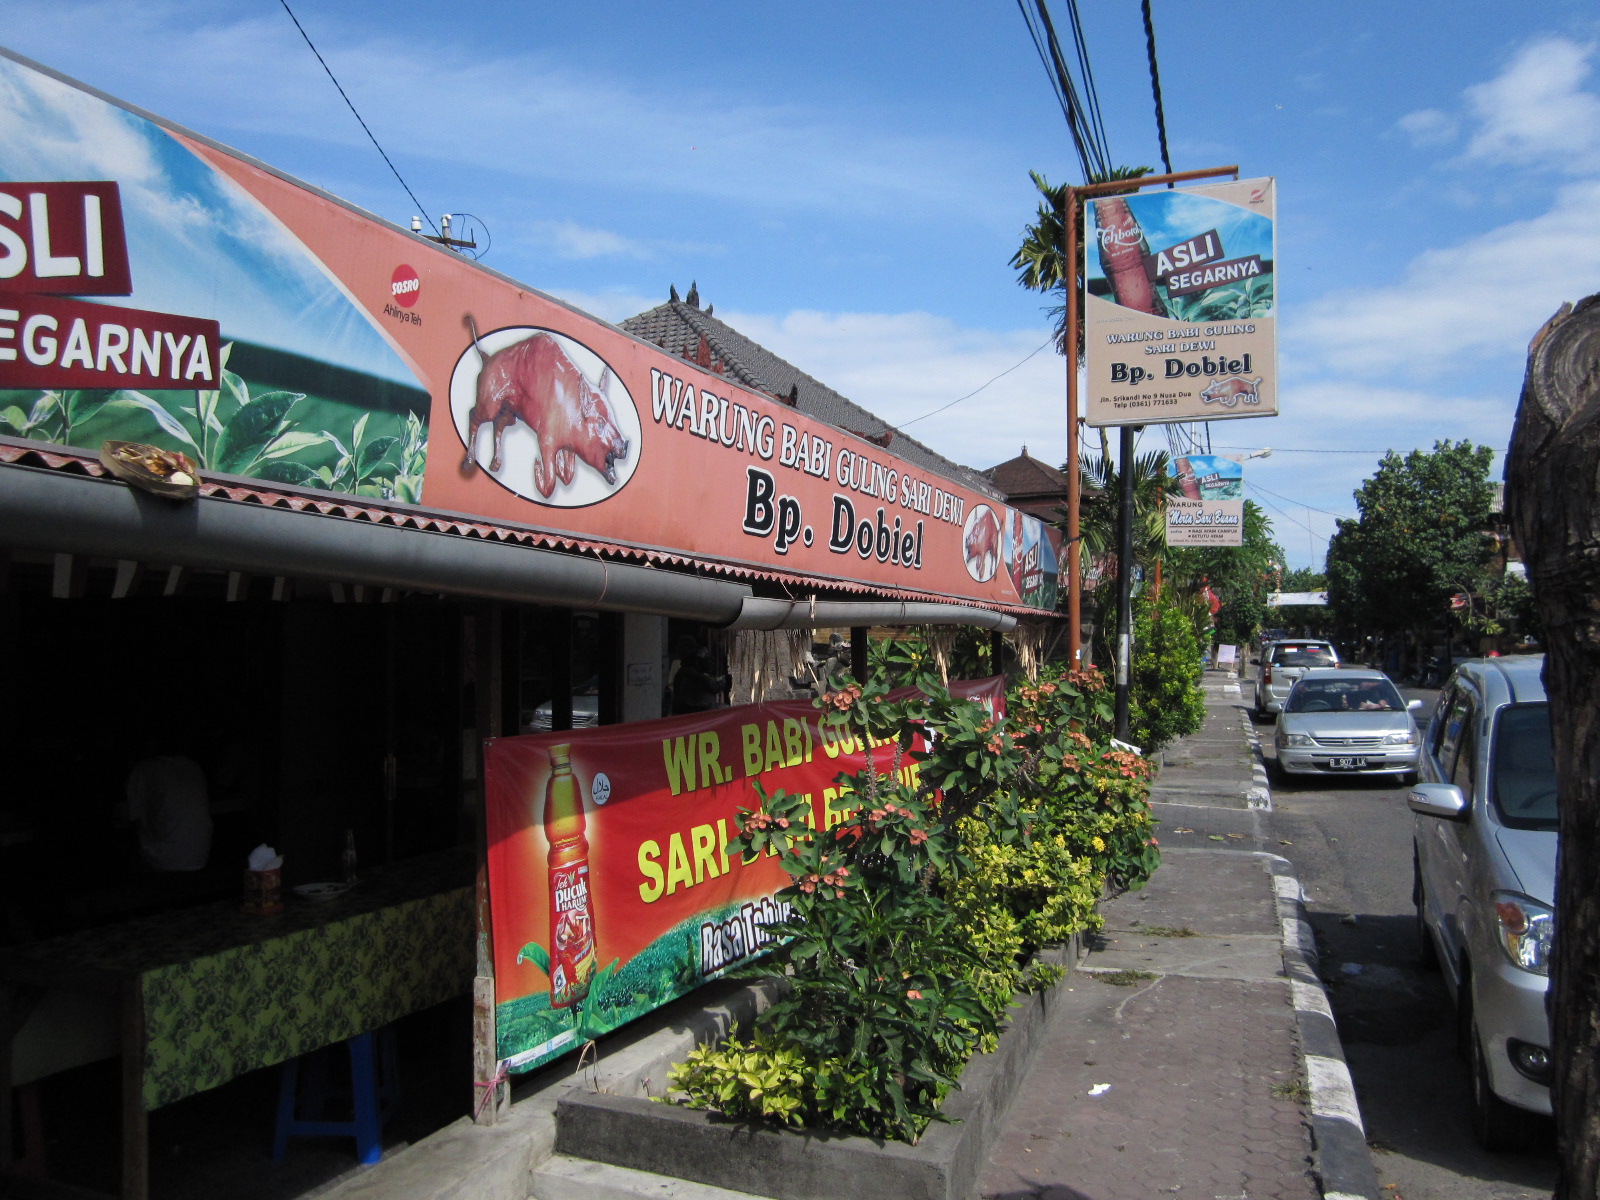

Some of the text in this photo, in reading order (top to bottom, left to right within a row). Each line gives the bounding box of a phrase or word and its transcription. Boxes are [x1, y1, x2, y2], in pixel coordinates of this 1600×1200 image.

[1157, 235, 1214, 276] ASLI
[392, 279, 419, 295] SOSRO
[1169, 260, 1259, 290] SEGARNYA
[383, 304, 422, 326] Ahlinya Teh
[1106, 323, 1255, 344] WARUNG BABI GULING
[1145, 341, 1217, 354] SARI DEWI
[1110, 353, 1252, 385] Bp. Dobiel
[1113, 394, 1140, 402] Srikandi
[1129, 400, 1151, 408] (0361)
[650, 367, 965, 527] WARUNG BABI GULING SARI DEWI
[1201, 473, 1219, 484] ASLI
[743, 465, 924, 569] Bp. Dobiel
[1024, 544, 1038, 574] ASLI
[662, 730, 733, 796] WR.
[741, 716, 813, 777] BABI
[1329, 758, 1335, 766] B
[1356, 757, 1367, 766] LK
[638, 818, 730, 904] SARI
[555, 877, 588, 912] pucuk
[561, 894, 588, 912] HARUM
[701, 915, 746, 977] Rasa
